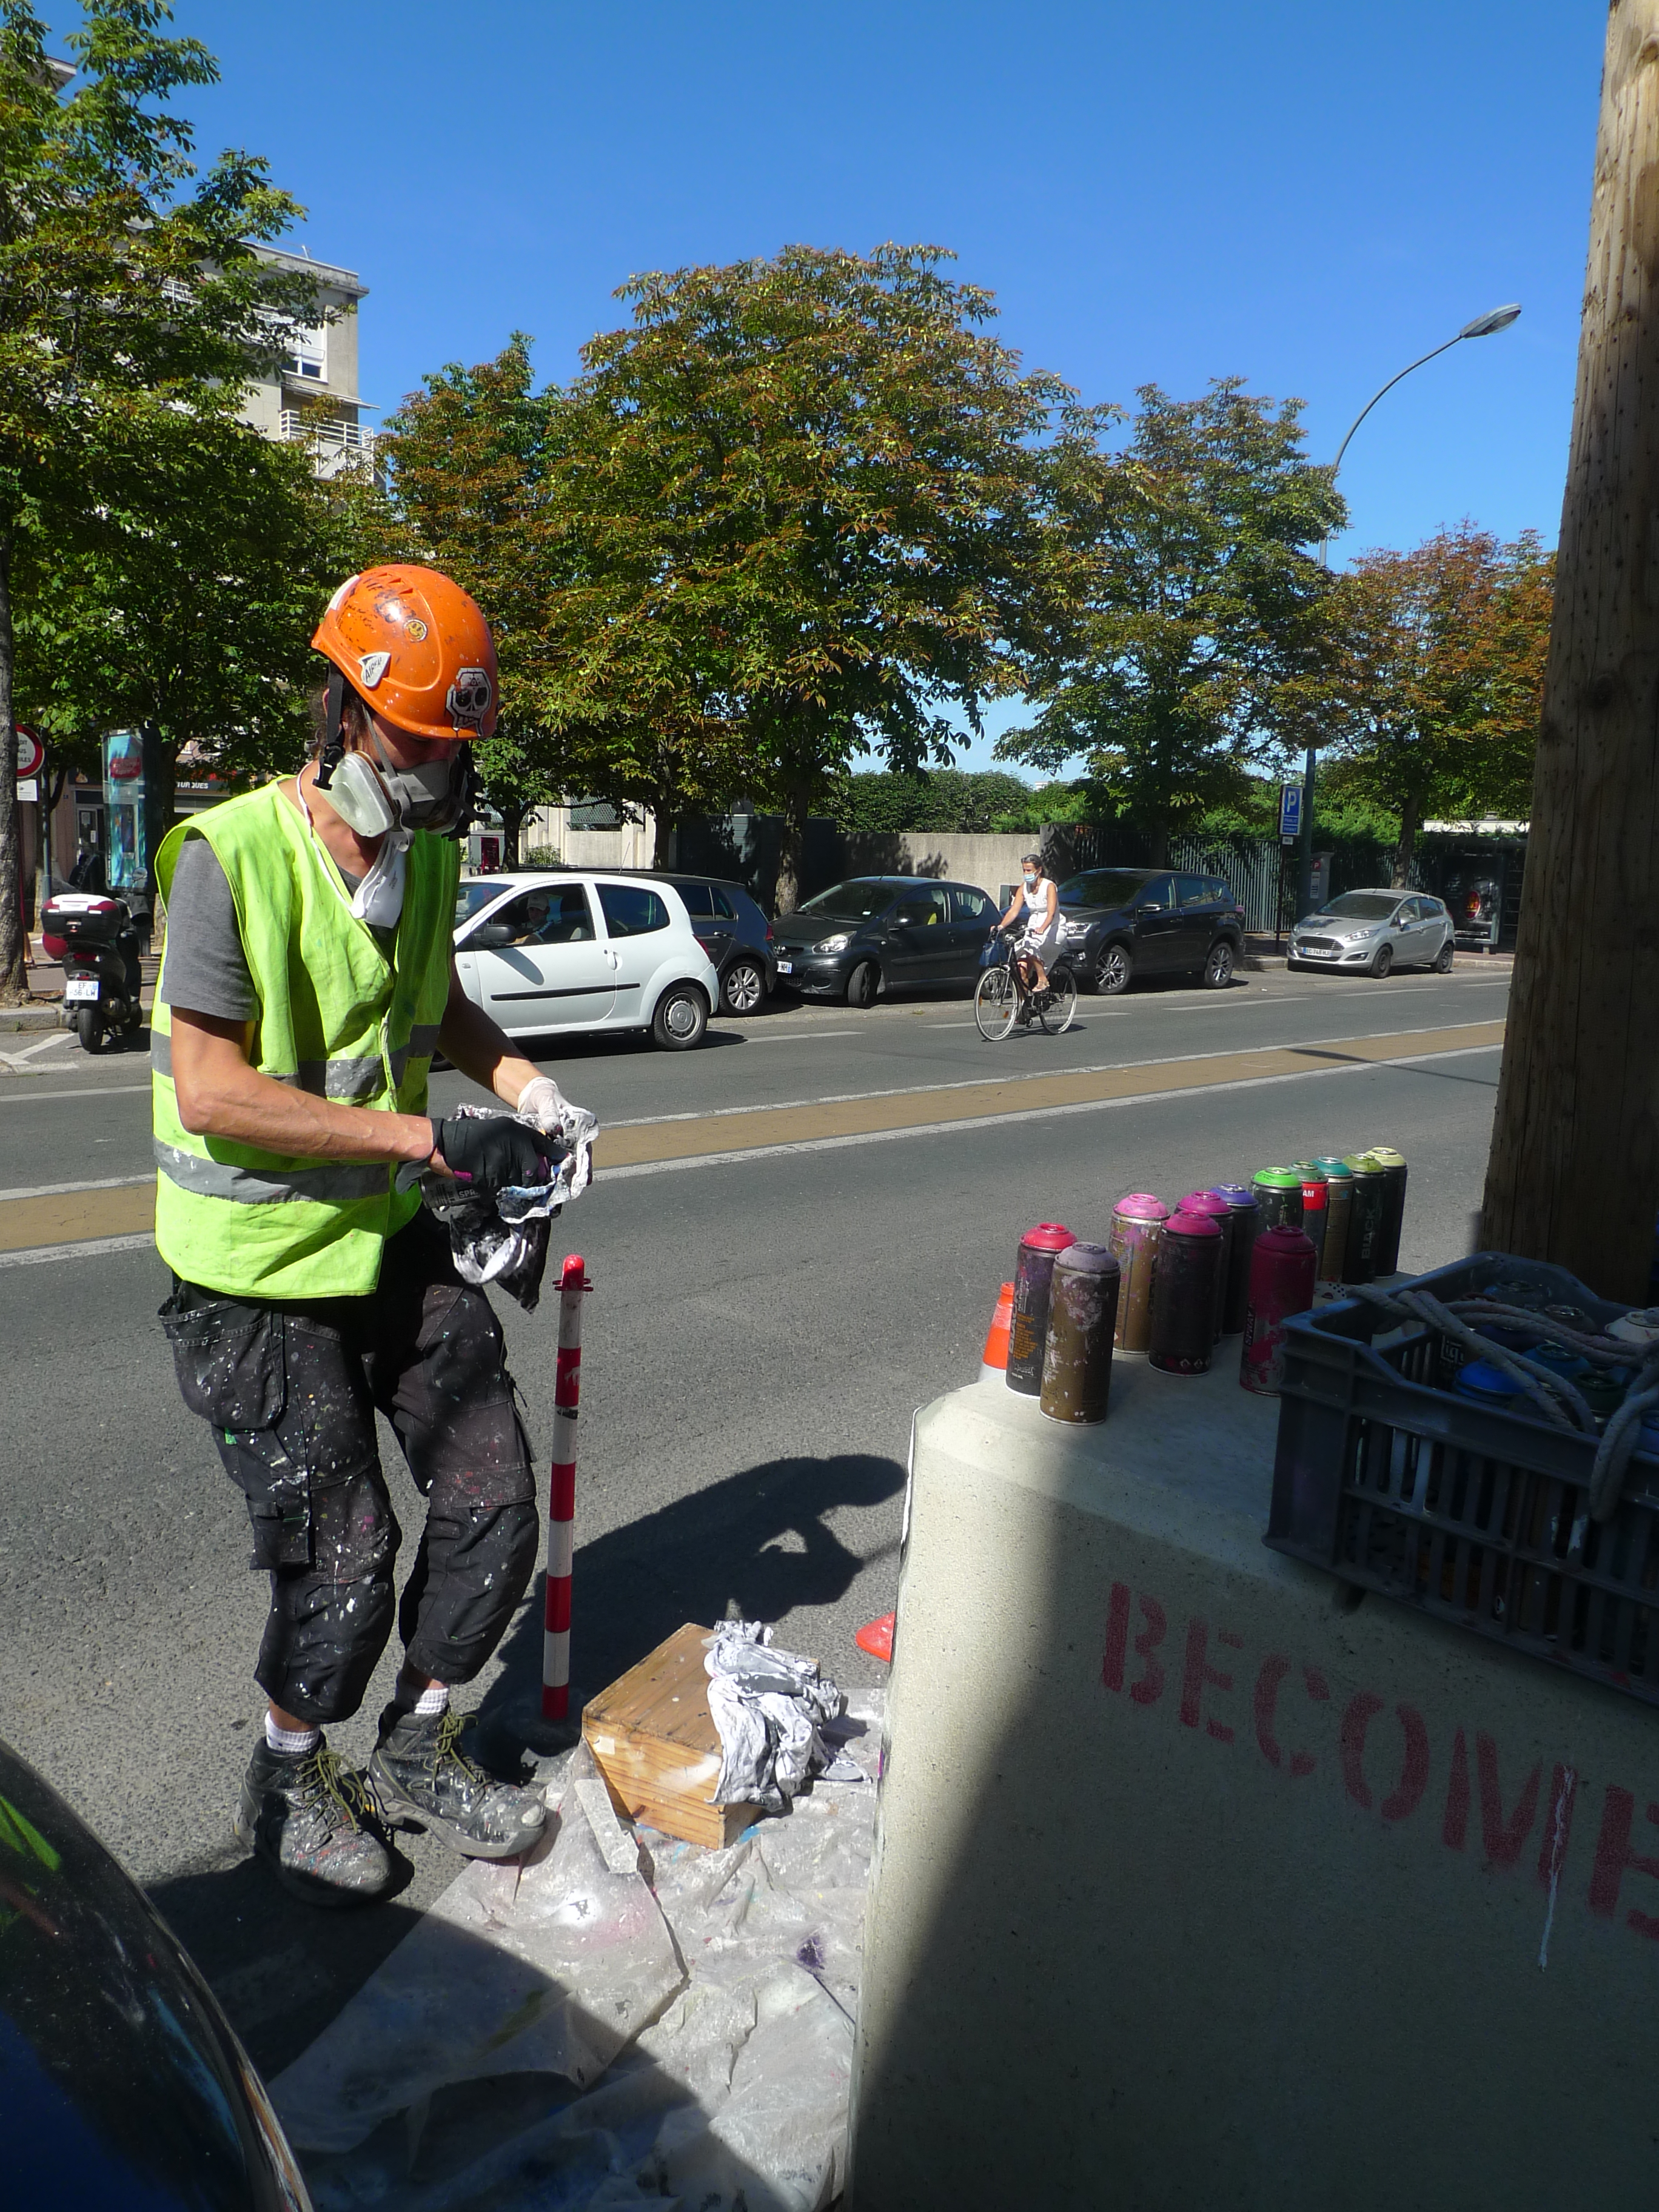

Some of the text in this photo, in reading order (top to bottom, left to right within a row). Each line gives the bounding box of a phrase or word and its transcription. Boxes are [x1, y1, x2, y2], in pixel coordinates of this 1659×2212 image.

[1287, 791, 1297, 813] P
[1361, 1207, 1375, 1259] BLACK
[1101, 1581, 1659, 1939] BECOME
